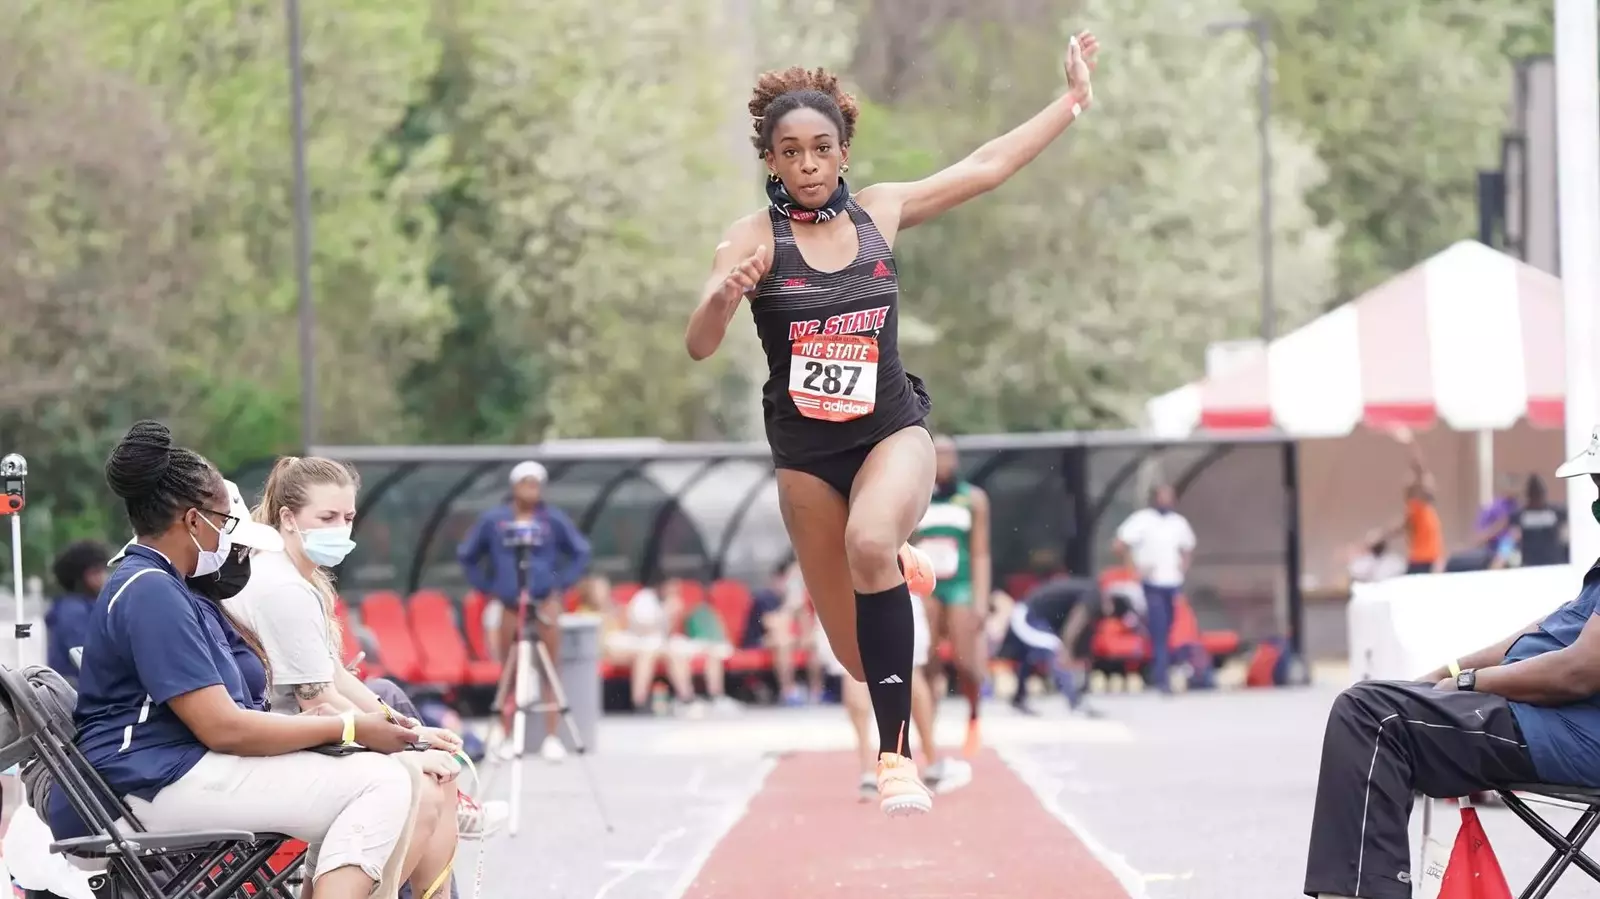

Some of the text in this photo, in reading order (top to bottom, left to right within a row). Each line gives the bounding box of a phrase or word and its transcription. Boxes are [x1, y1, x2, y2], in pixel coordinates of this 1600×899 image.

[789, 306, 890, 340] NC STATE
[801, 343, 870, 360] NC STATE
[803, 361, 862, 396] 287
[822, 401, 868, 414] adidas
